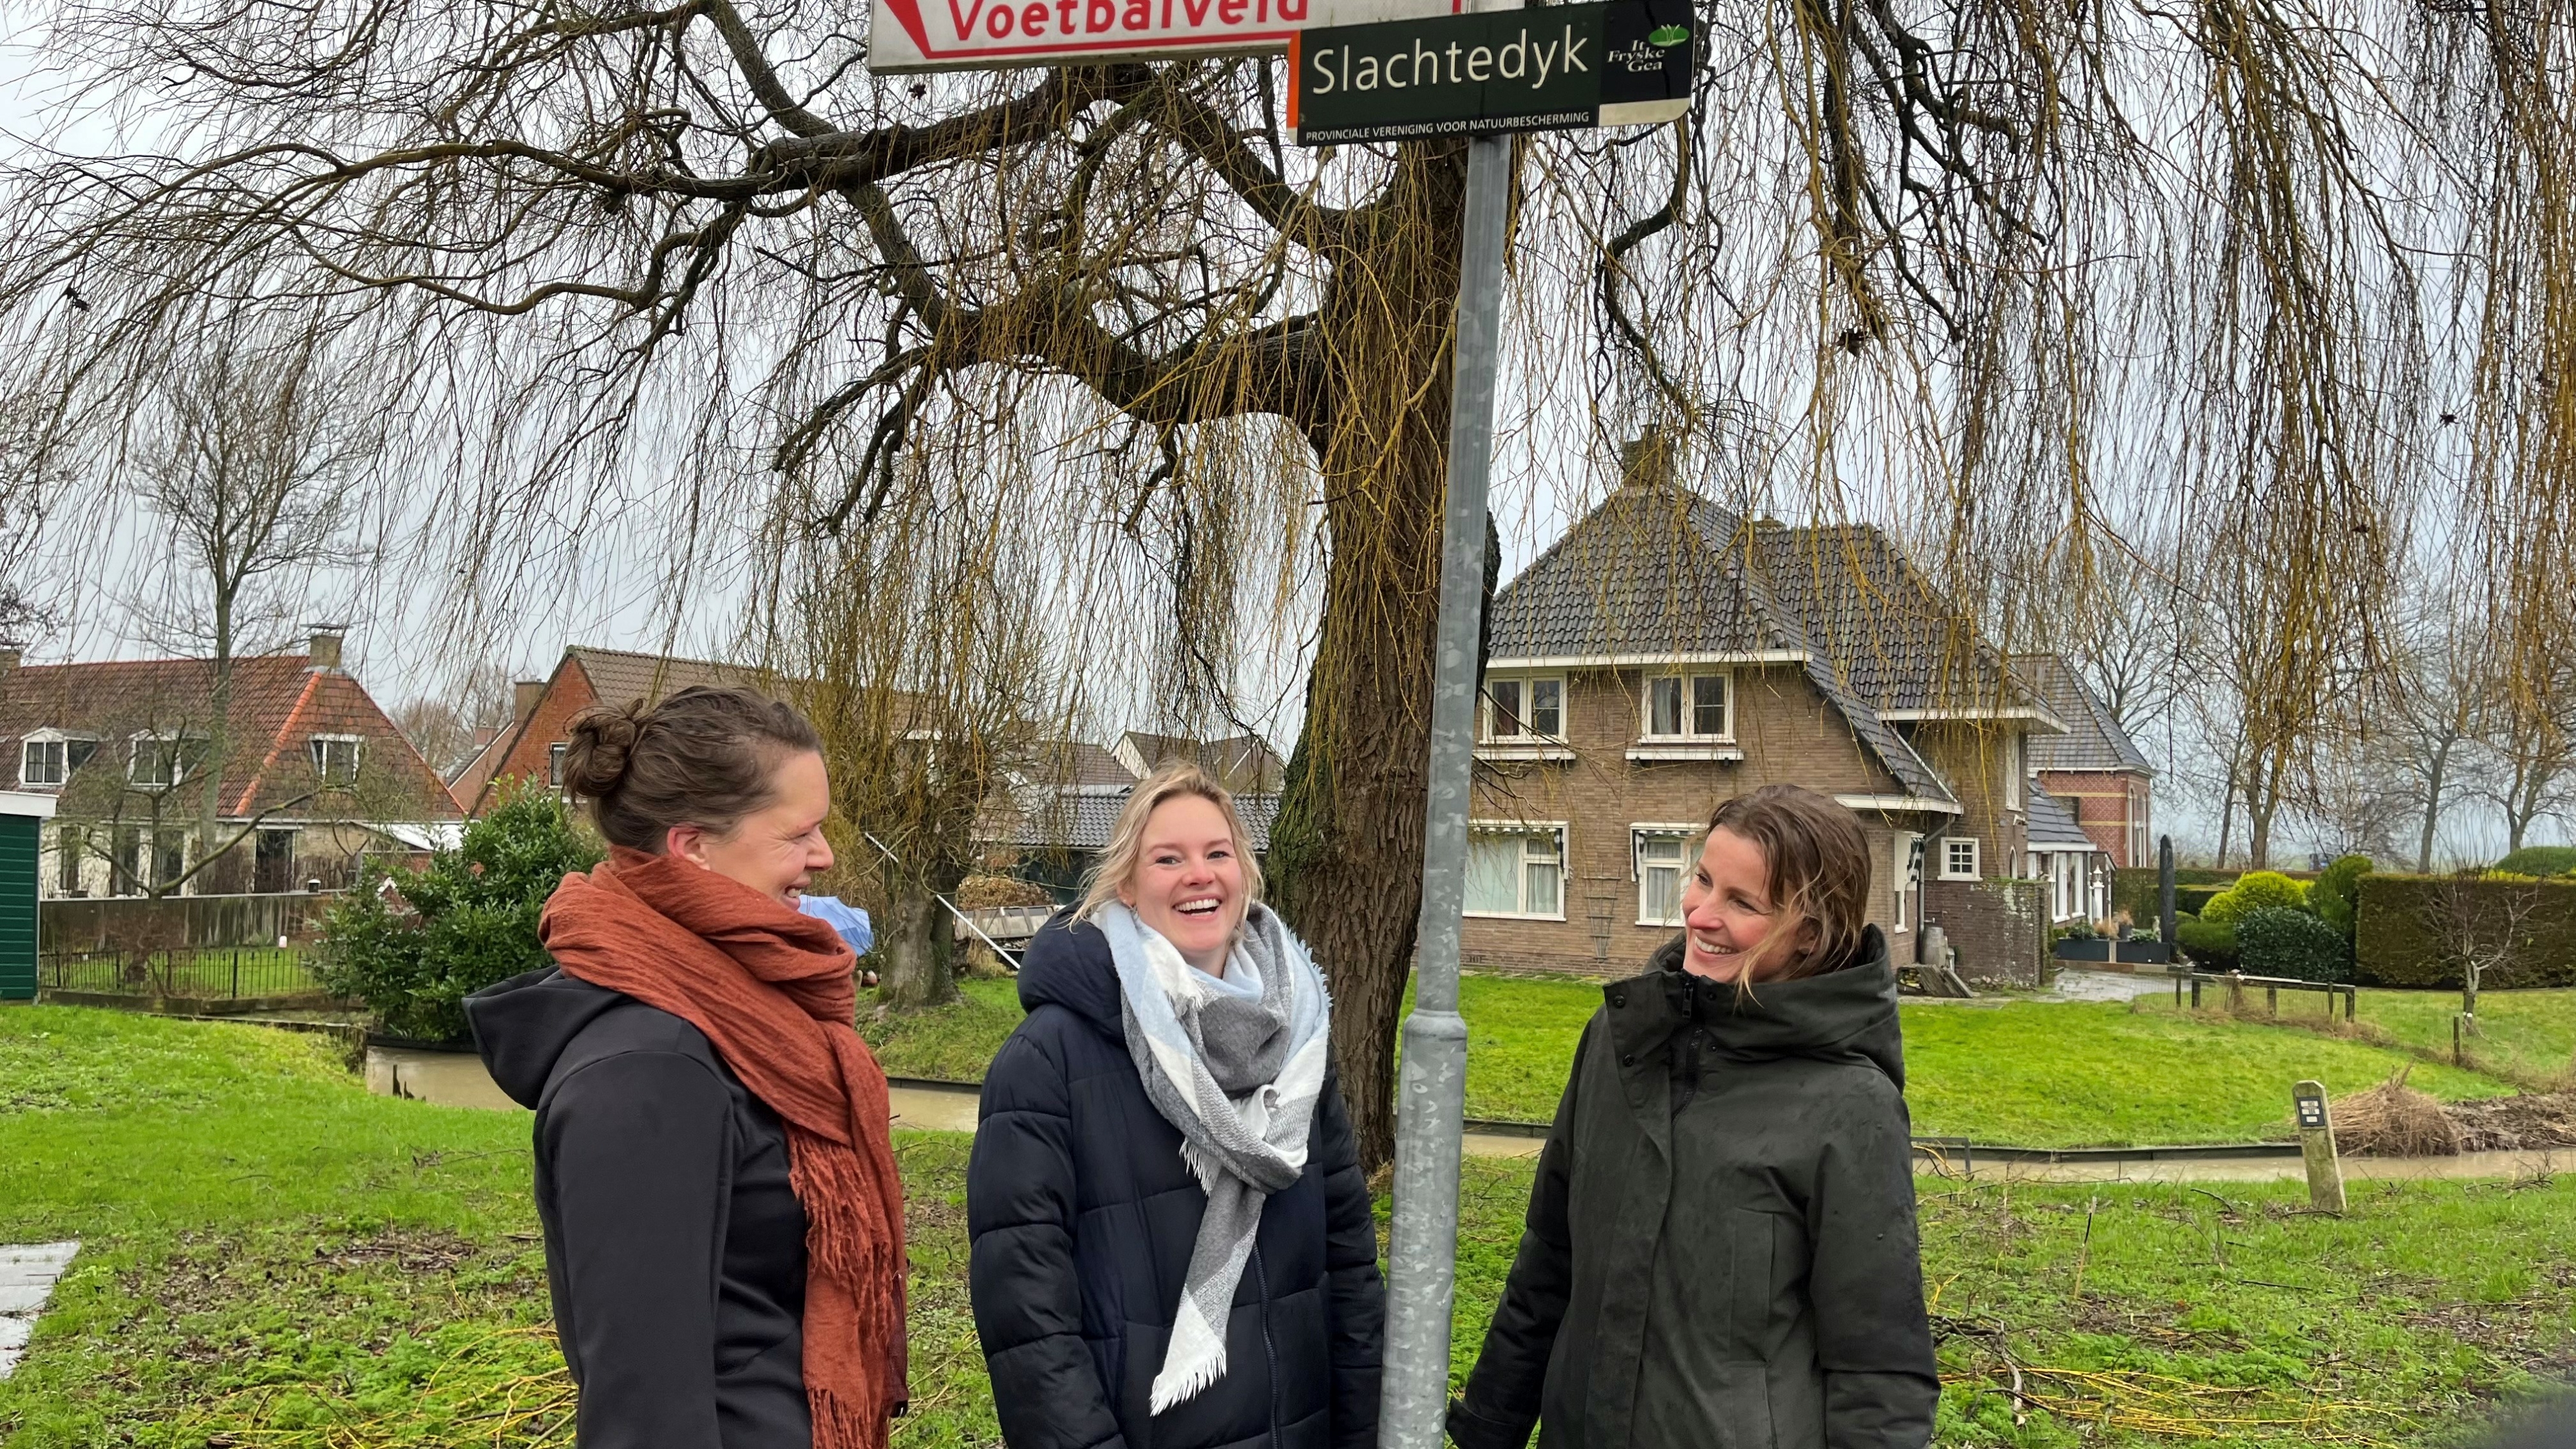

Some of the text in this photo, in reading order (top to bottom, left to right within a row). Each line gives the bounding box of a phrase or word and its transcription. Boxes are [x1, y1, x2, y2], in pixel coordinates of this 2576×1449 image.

[1632, 39, 1646, 52] It
[1312, 24, 1588, 95] Slachtedyk
[1607, 46, 1665, 64] Fryske
[1627, 59, 1663, 72] Gea
[1306, 111, 1589, 141] PROVINCIALE VERENIGING VOOR NATUURBESCHERMING
